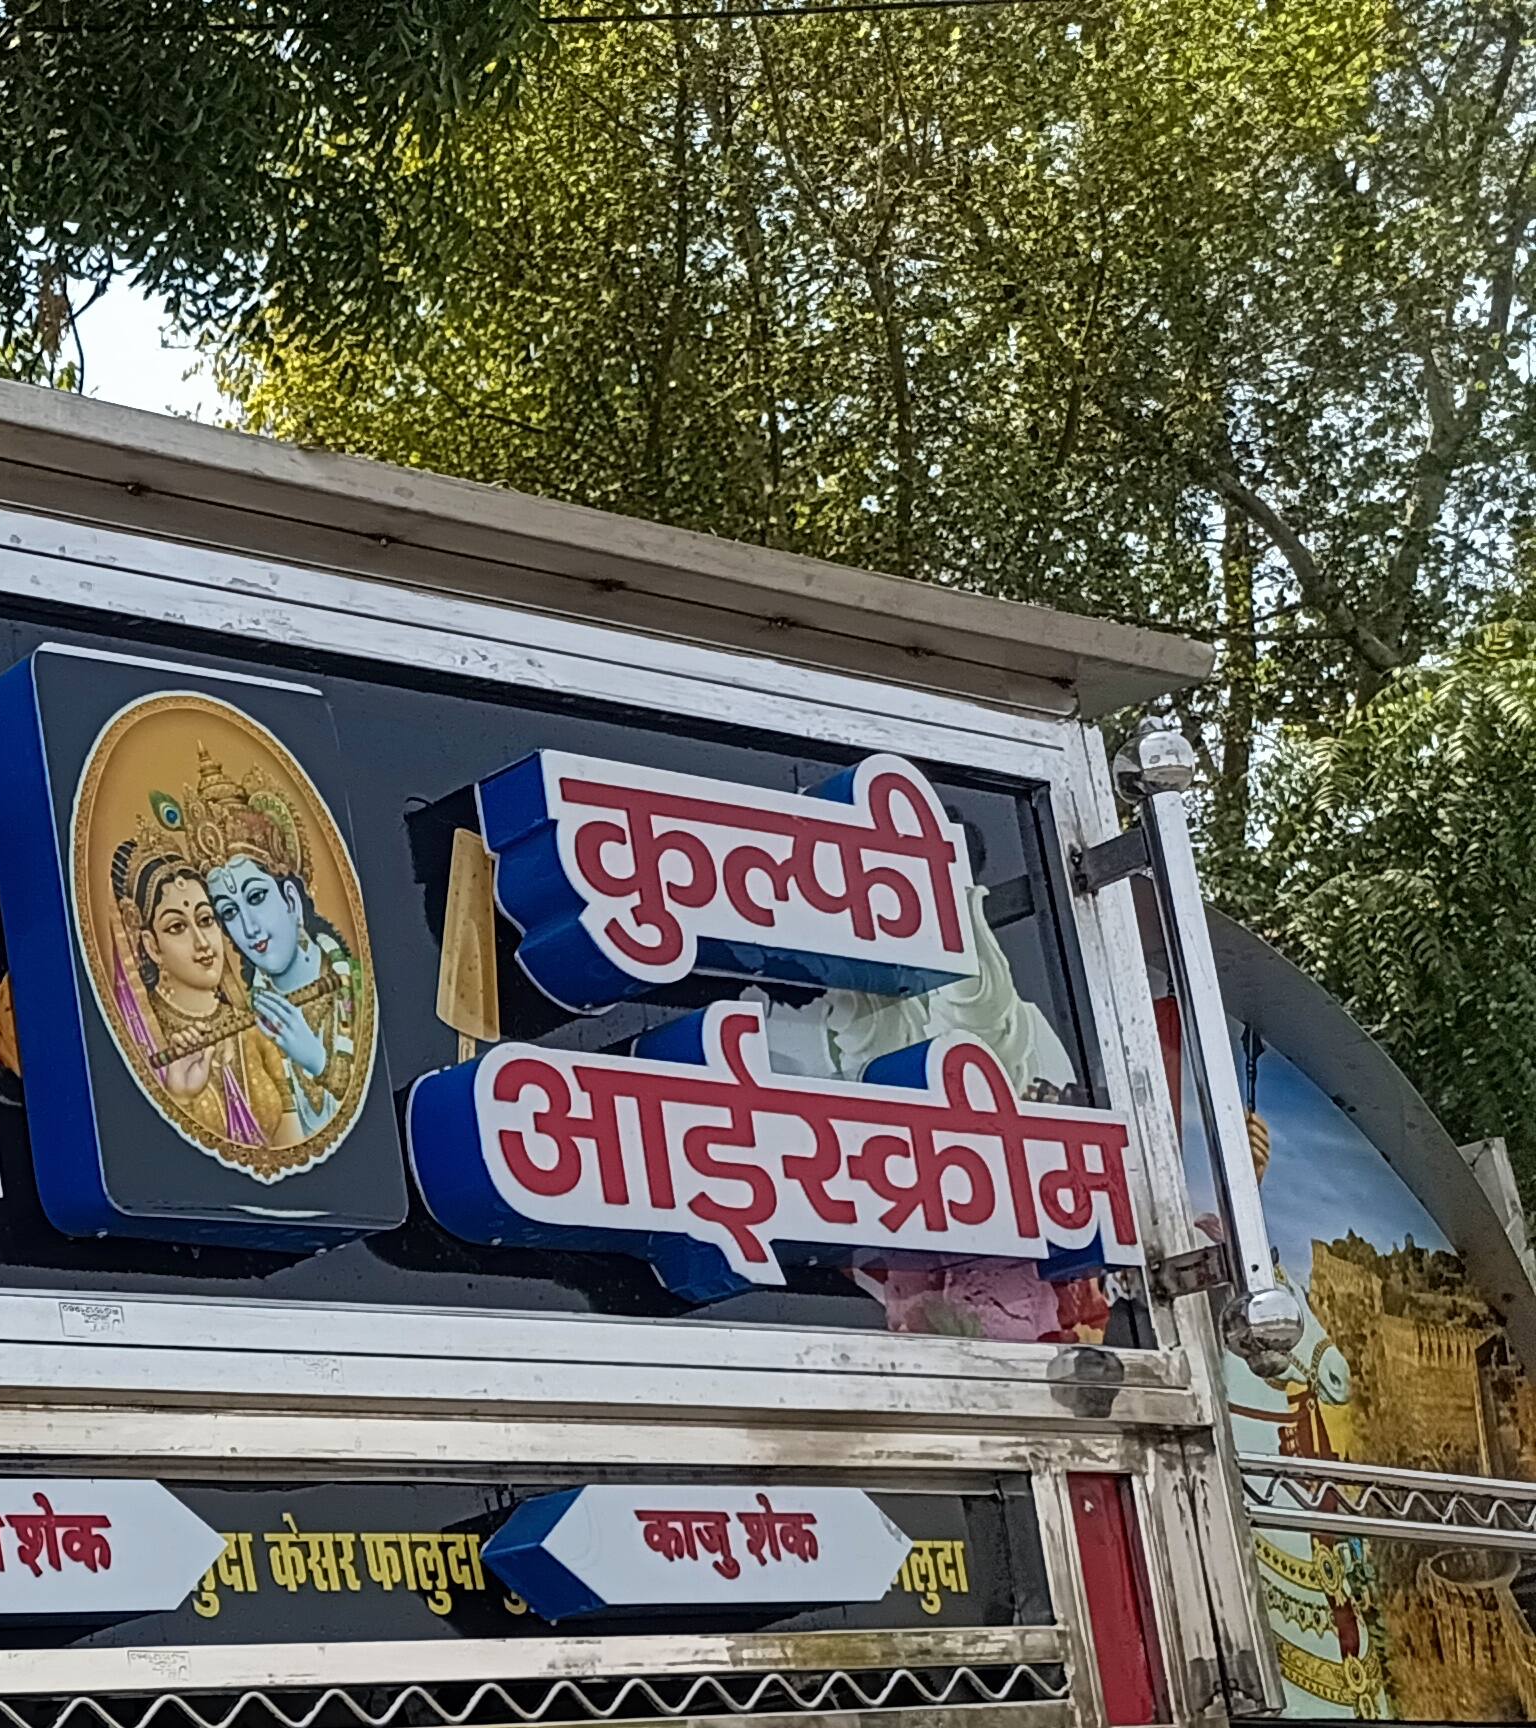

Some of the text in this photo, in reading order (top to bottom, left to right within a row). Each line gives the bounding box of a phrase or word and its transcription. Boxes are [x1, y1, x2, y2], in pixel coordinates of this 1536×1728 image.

[560, 772, 965, 966] कुल्फी
[493, 1013, 1138, 1263] आईस्क्रीम
[5, 1492, 112, 1578] शेक
[264, 1512, 361, 1592] केसर
[360, 1533, 486, 1615] फालुदा
[634, 1493, 819, 1579] काजु शेक
